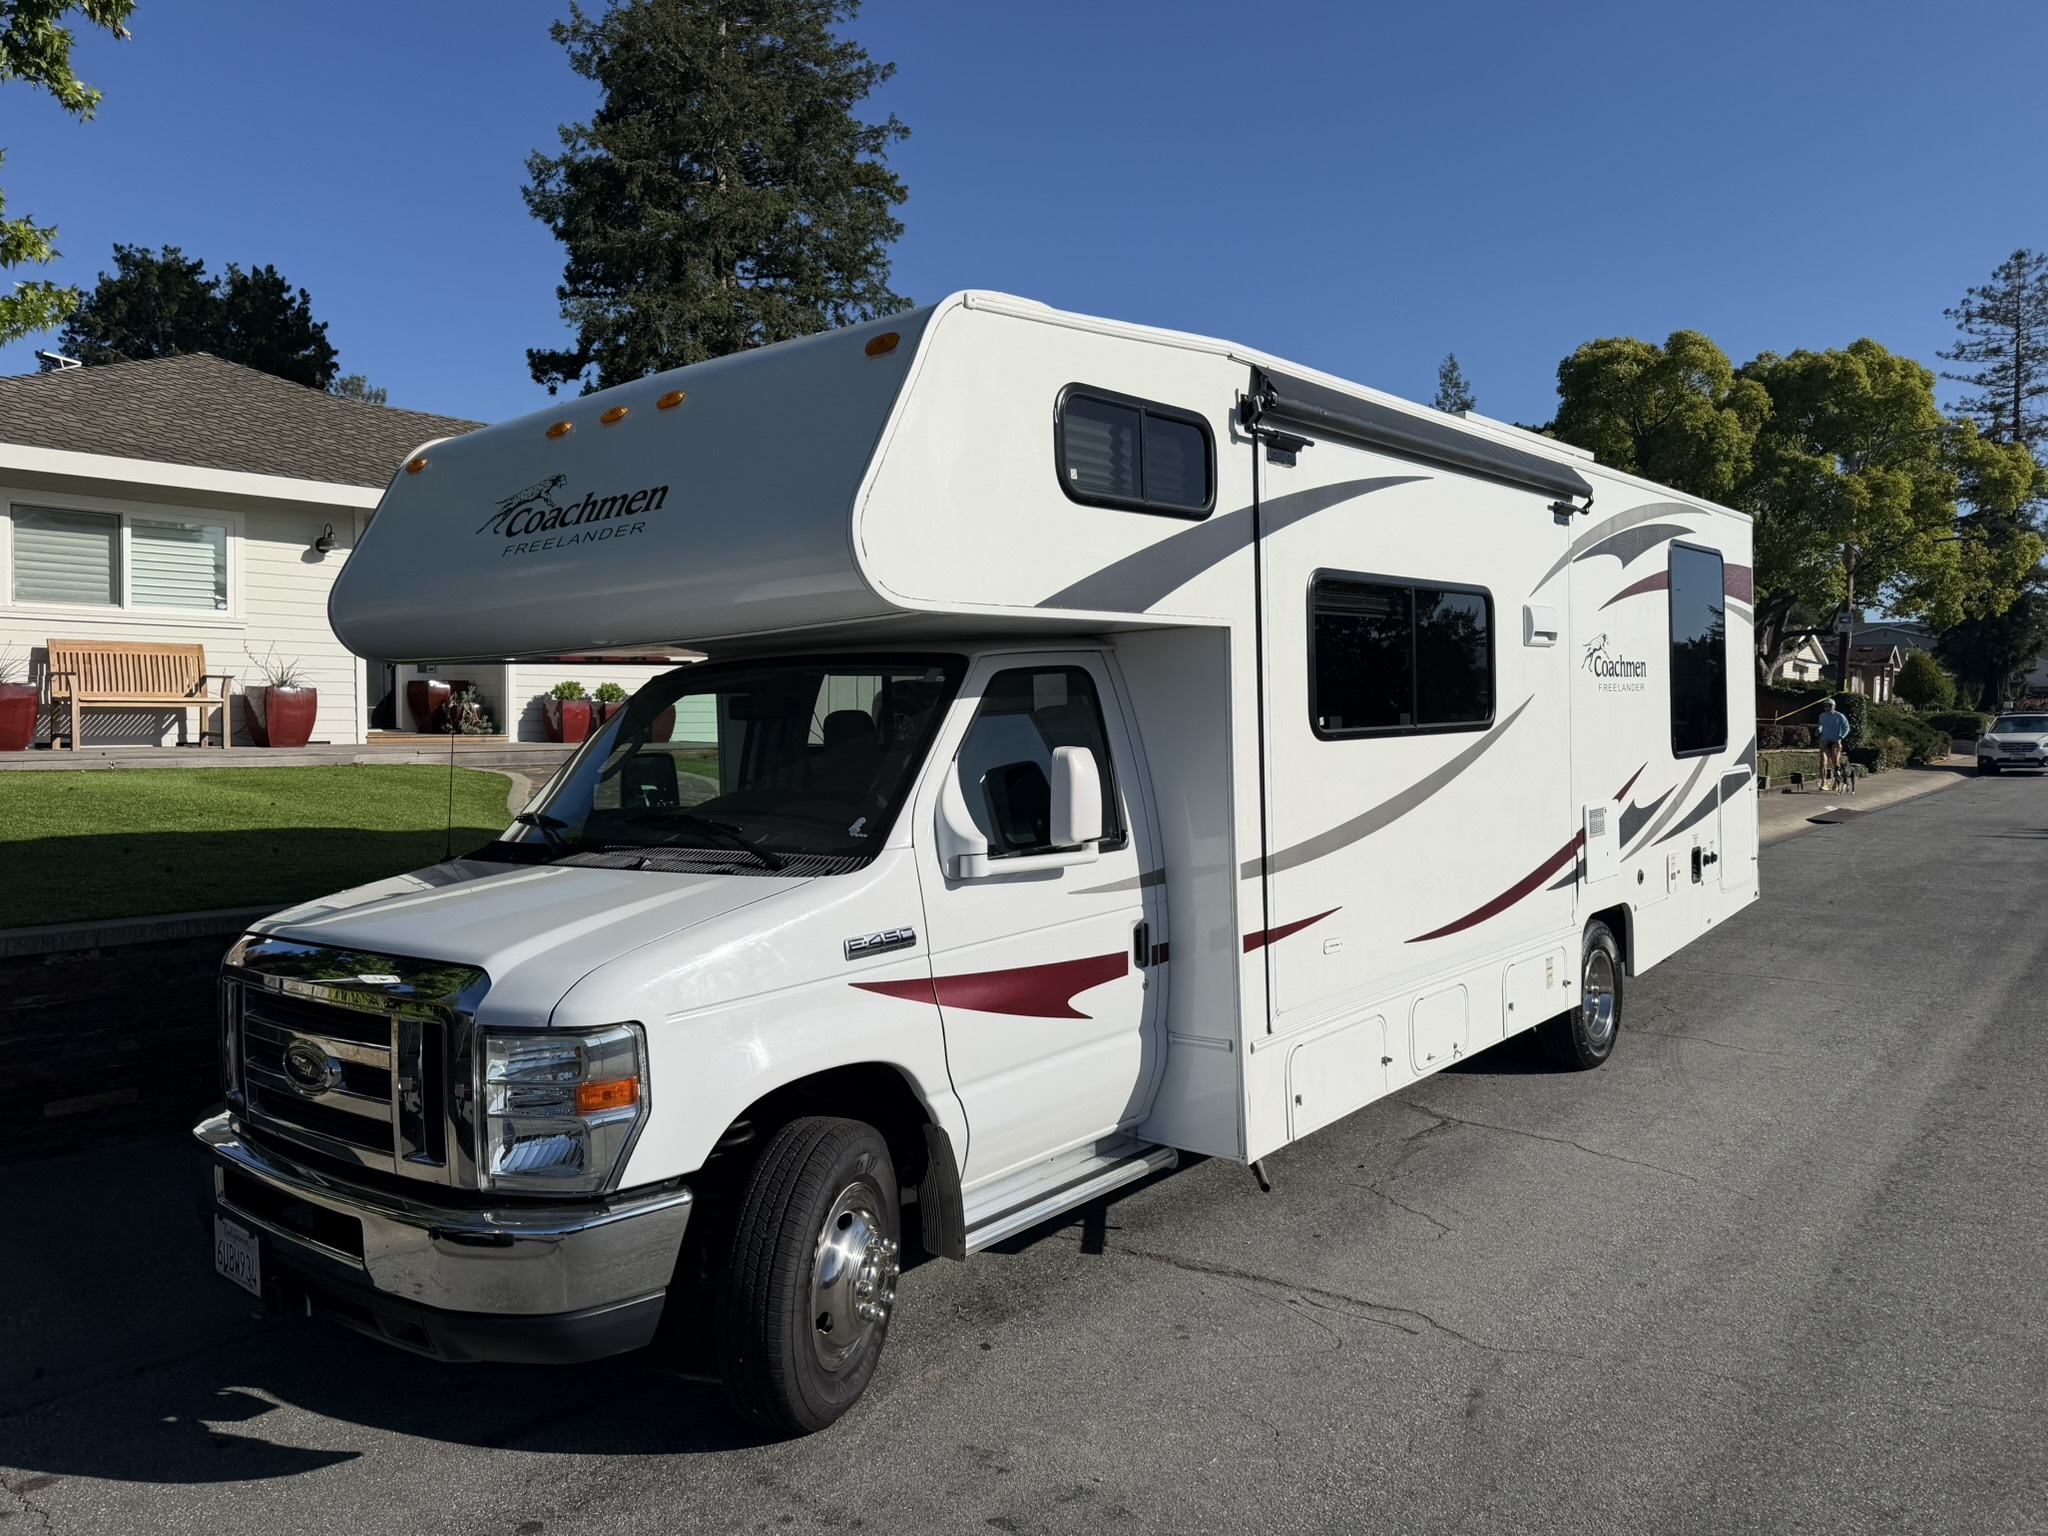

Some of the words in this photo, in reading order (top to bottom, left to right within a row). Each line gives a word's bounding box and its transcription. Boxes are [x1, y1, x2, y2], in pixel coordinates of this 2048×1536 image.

[505, 485, 669, 538] Coachmen
[502, 521, 646, 558] FREELANDER
[1594, 654, 1647, 677] Coachmen
[1598, 683, 1645, 692] FREELANDER
